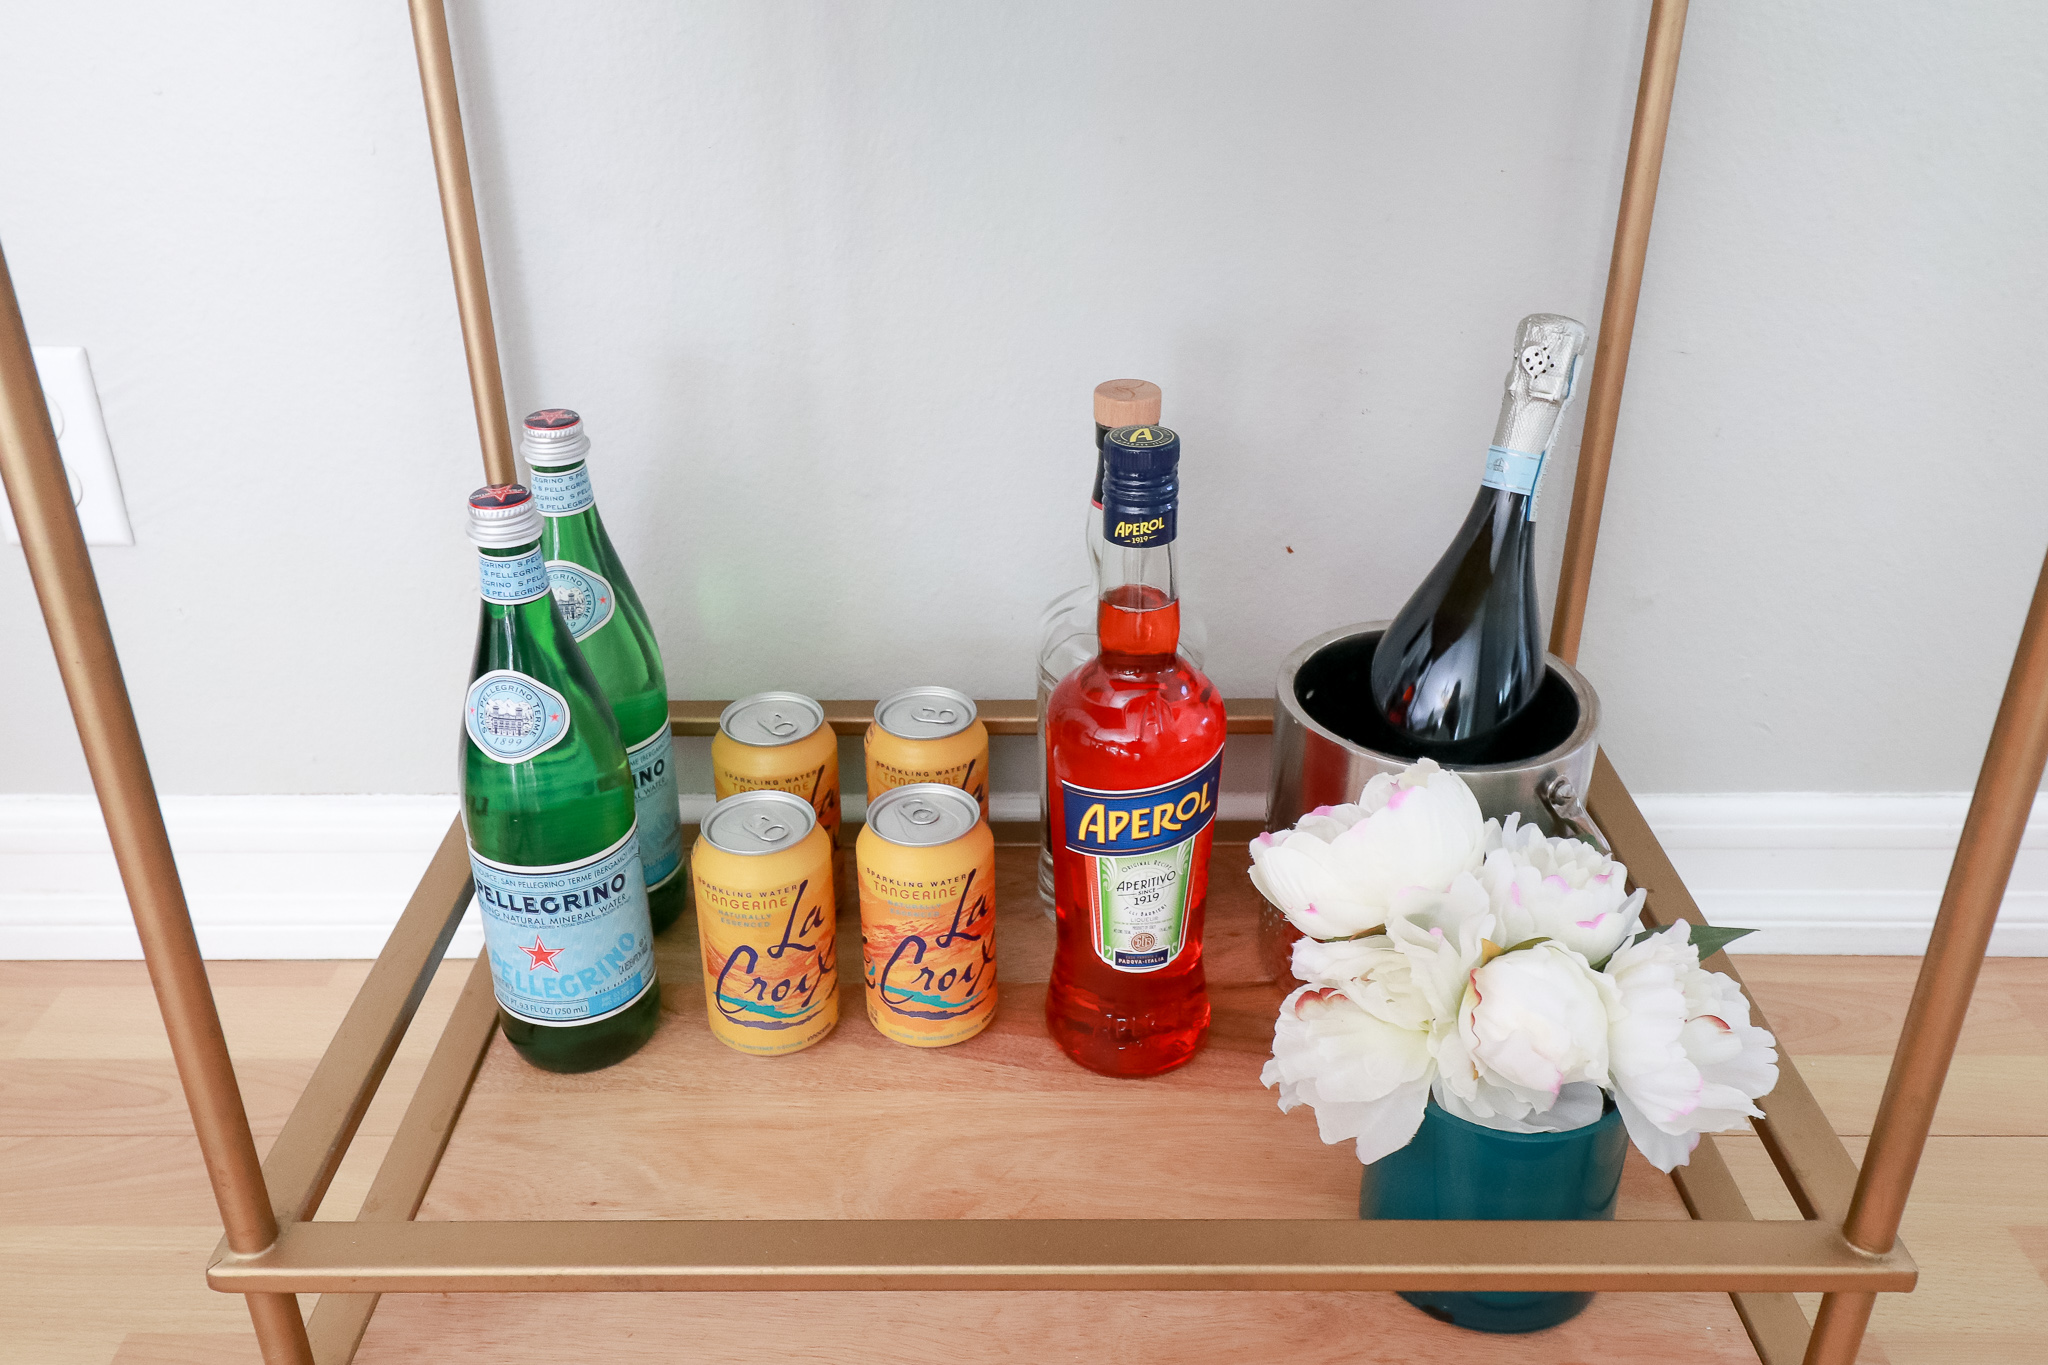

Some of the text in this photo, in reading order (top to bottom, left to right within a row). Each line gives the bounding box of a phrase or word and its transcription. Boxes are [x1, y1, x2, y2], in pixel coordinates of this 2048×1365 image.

[1129, 428, 1153, 442] A
[1114, 517, 1164, 538] APEROL
[1132, 536, 1148, 544] 1919
[480, 684, 532, 707] PELLEGRINO
[530, 702, 541, 738] TERME
[494, 738, 522, 746] 1899
[724, 770, 816, 786] SPARKLING WATER
[876, 760, 968, 776] SPARKLING WATER
[1078, 782, 1211, 844] APEROL
[1122, 860, 1150, 872] ORIGINAL
[500, 878, 516, 887] SAN
[518, 880, 564, 889] PELLEGRINO
[568, 873, 592, 886] TERME
[698, 876, 797, 898] SPARKLING WATER
[866, 868, 966, 888] SPARKLING WATER
[1116, 870, 1176, 892] APERITIVO
[476, 873, 626, 915] PELLEGRINO
[704, 890, 788, 910] TANGERINE
[874, 880, 957, 900] TANGERINE
[1134, 892, 1160, 906] 1919
[503, 913, 545, 926] NATURAL
[550, 911, 595, 925] MINERAL
[598, 894, 626, 913] WATER
[718, 910, 772, 920] NATURALLY
[936, 868, 989, 948] La
[720, 918, 771, 928] ESSENCED
[767, 880, 824, 958] La
[492, 932, 635, 999] PELLEGRINO
[554, 1007, 572, 1015] (750
[574, 1006, 588, 1014] mL)
